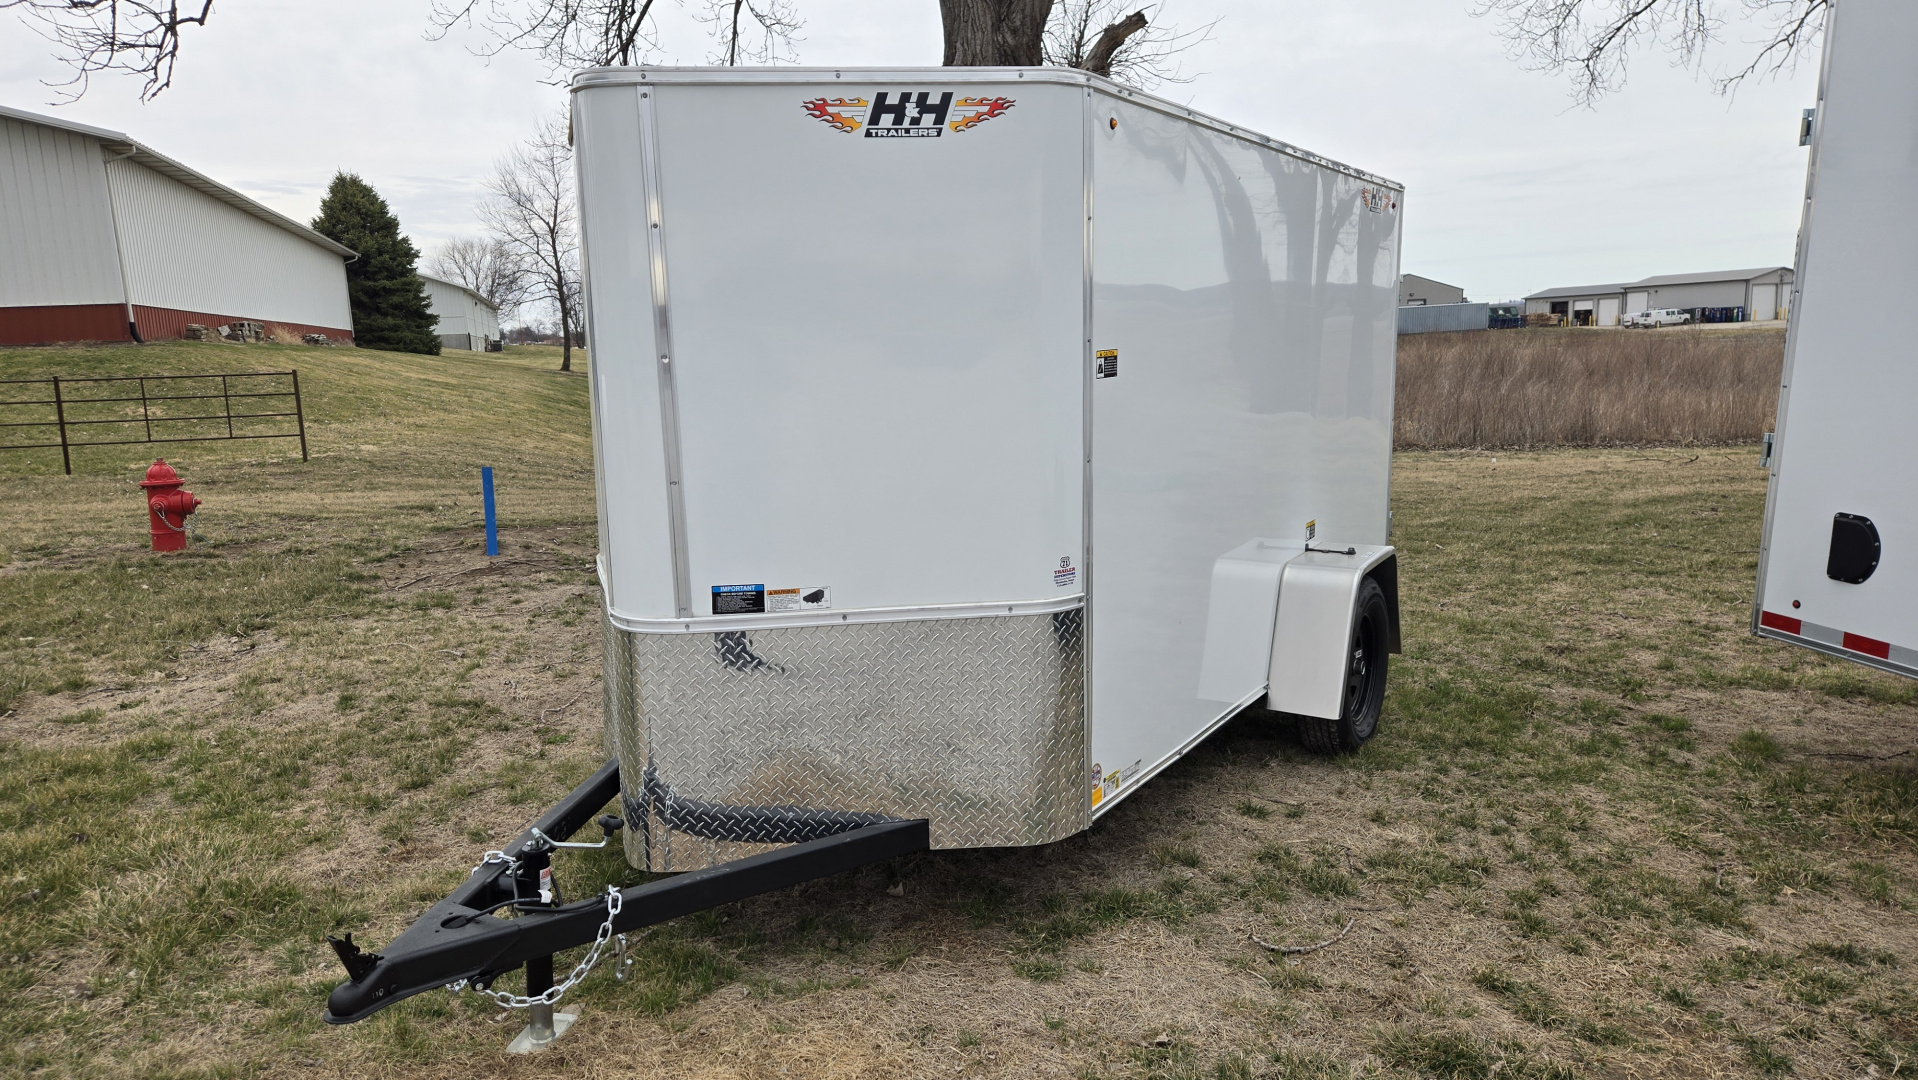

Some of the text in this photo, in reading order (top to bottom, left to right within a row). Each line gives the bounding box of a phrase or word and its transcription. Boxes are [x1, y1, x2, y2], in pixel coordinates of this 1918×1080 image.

[867, 91, 954, 126] H&H
[869, 129, 938, 137] TRAILERS
[1054, 567, 1075, 575] TRAILER
